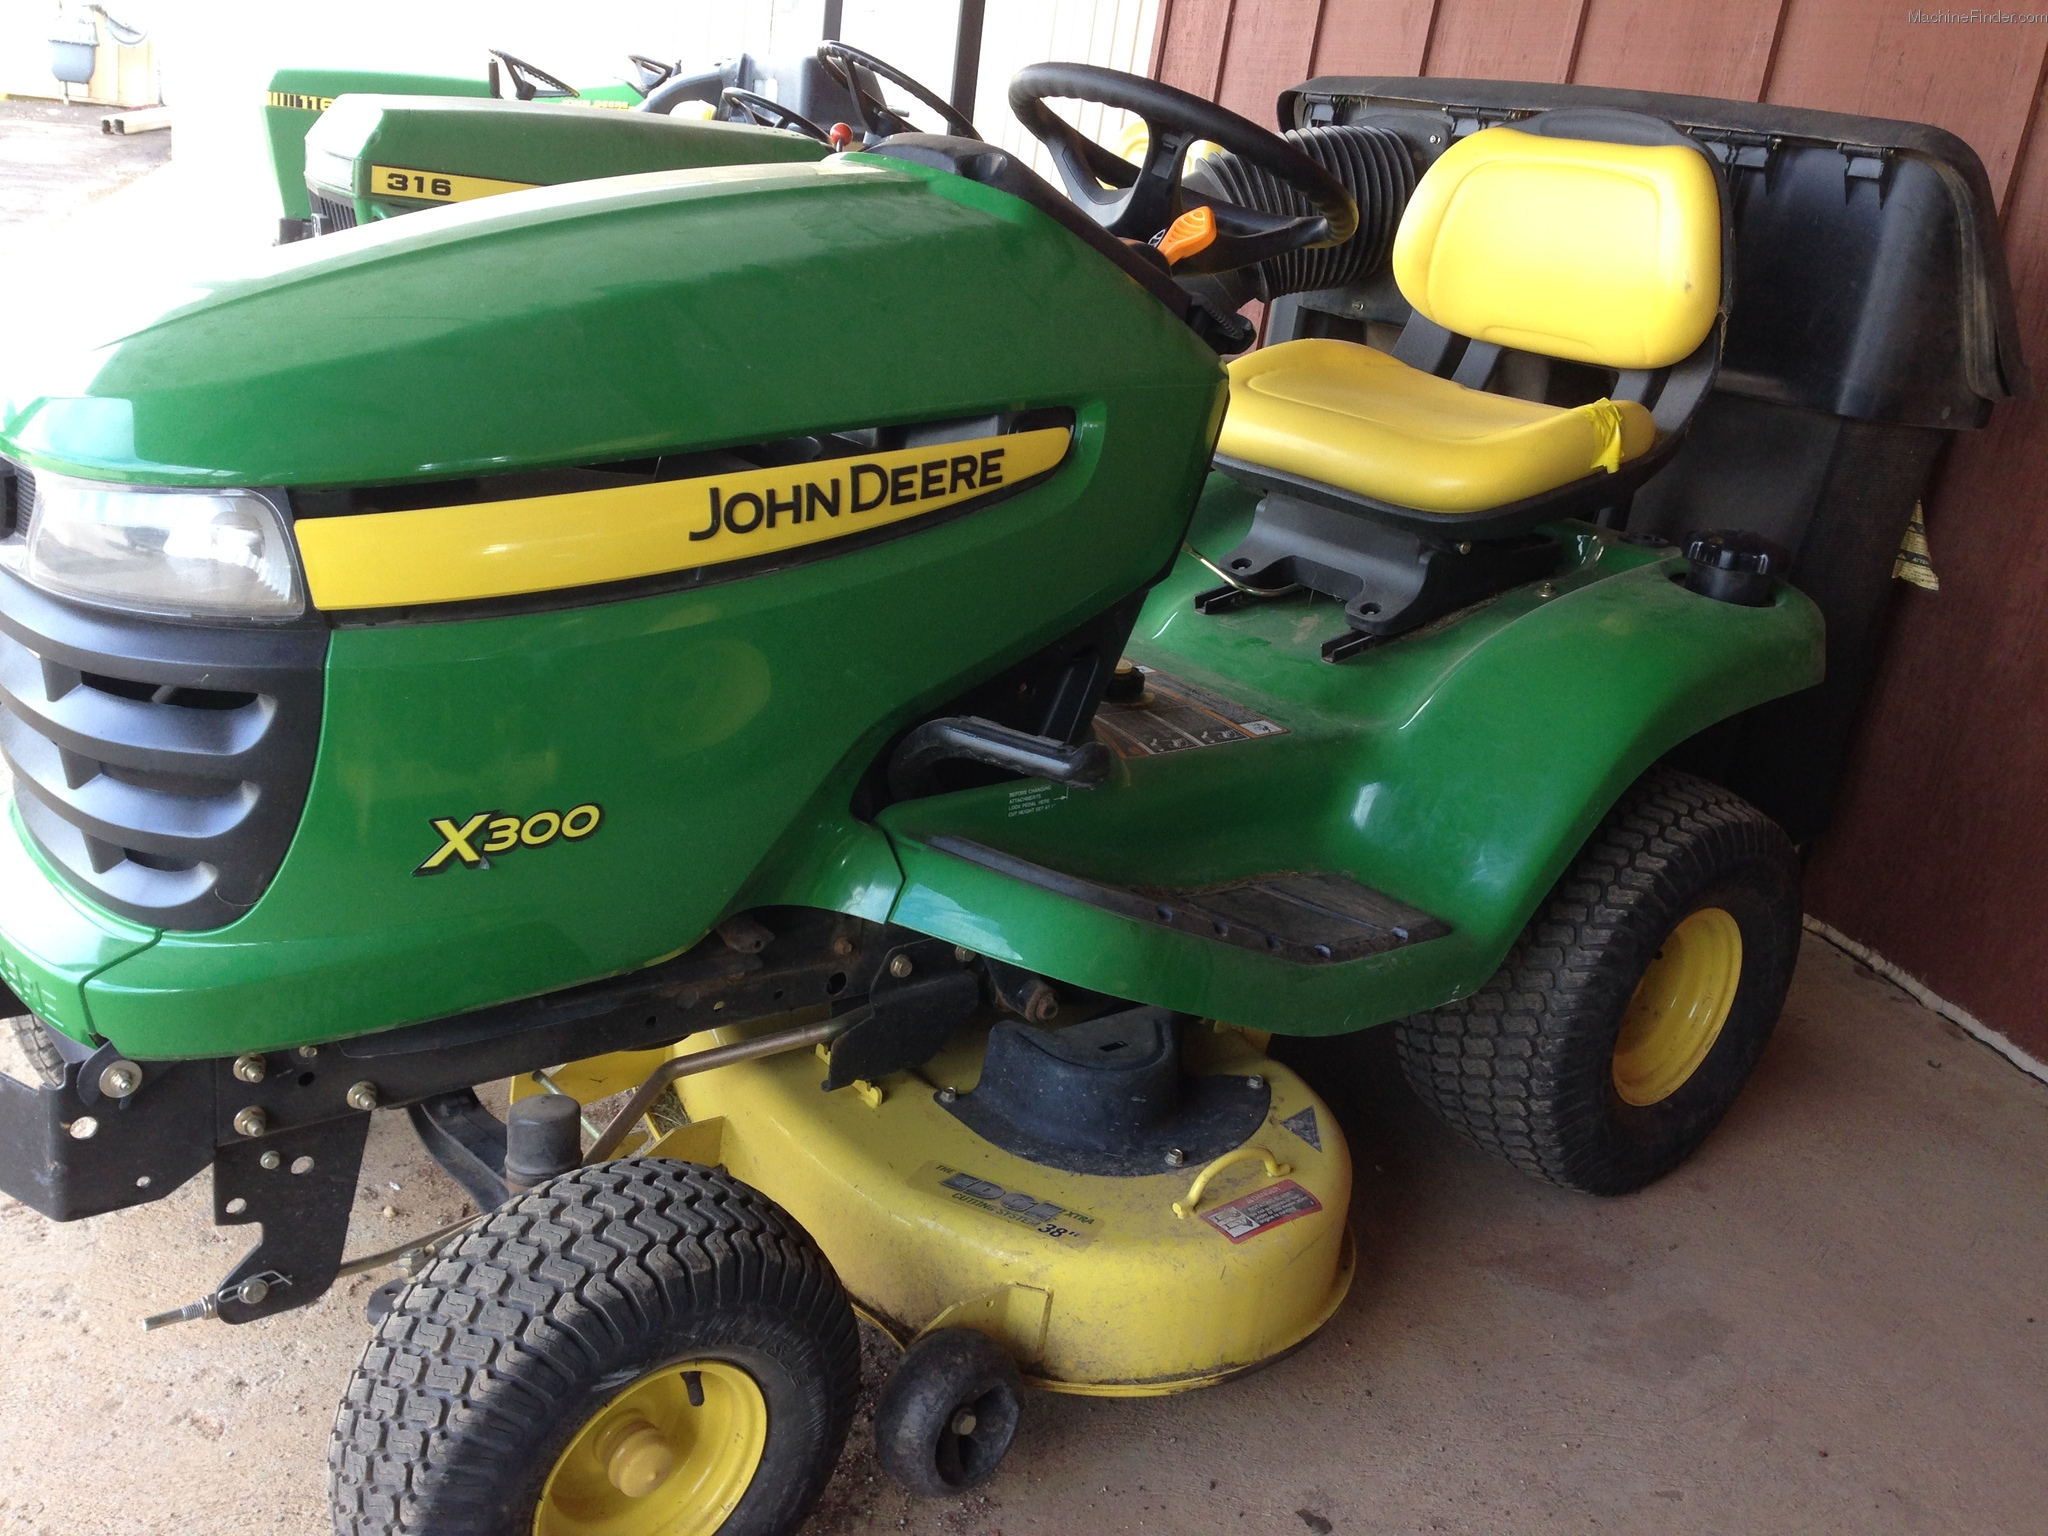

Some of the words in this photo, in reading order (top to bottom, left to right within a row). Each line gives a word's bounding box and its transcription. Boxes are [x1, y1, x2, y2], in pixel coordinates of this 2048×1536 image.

[386, 172, 452, 197] 316
[688, 478, 841, 542] JOHN
[849, 448, 1005, 514] DEERE
[411, 803, 604, 877] X300
[935, 1164, 957, 1174] THE
[939, 1171, 1066, 1222] EDGE
[1065, 1210, 1096, 1225] XTRA
[951, 1192, 995, 1213] CUTTING
[995, 1208, 1042, 1228] SYSTEM
